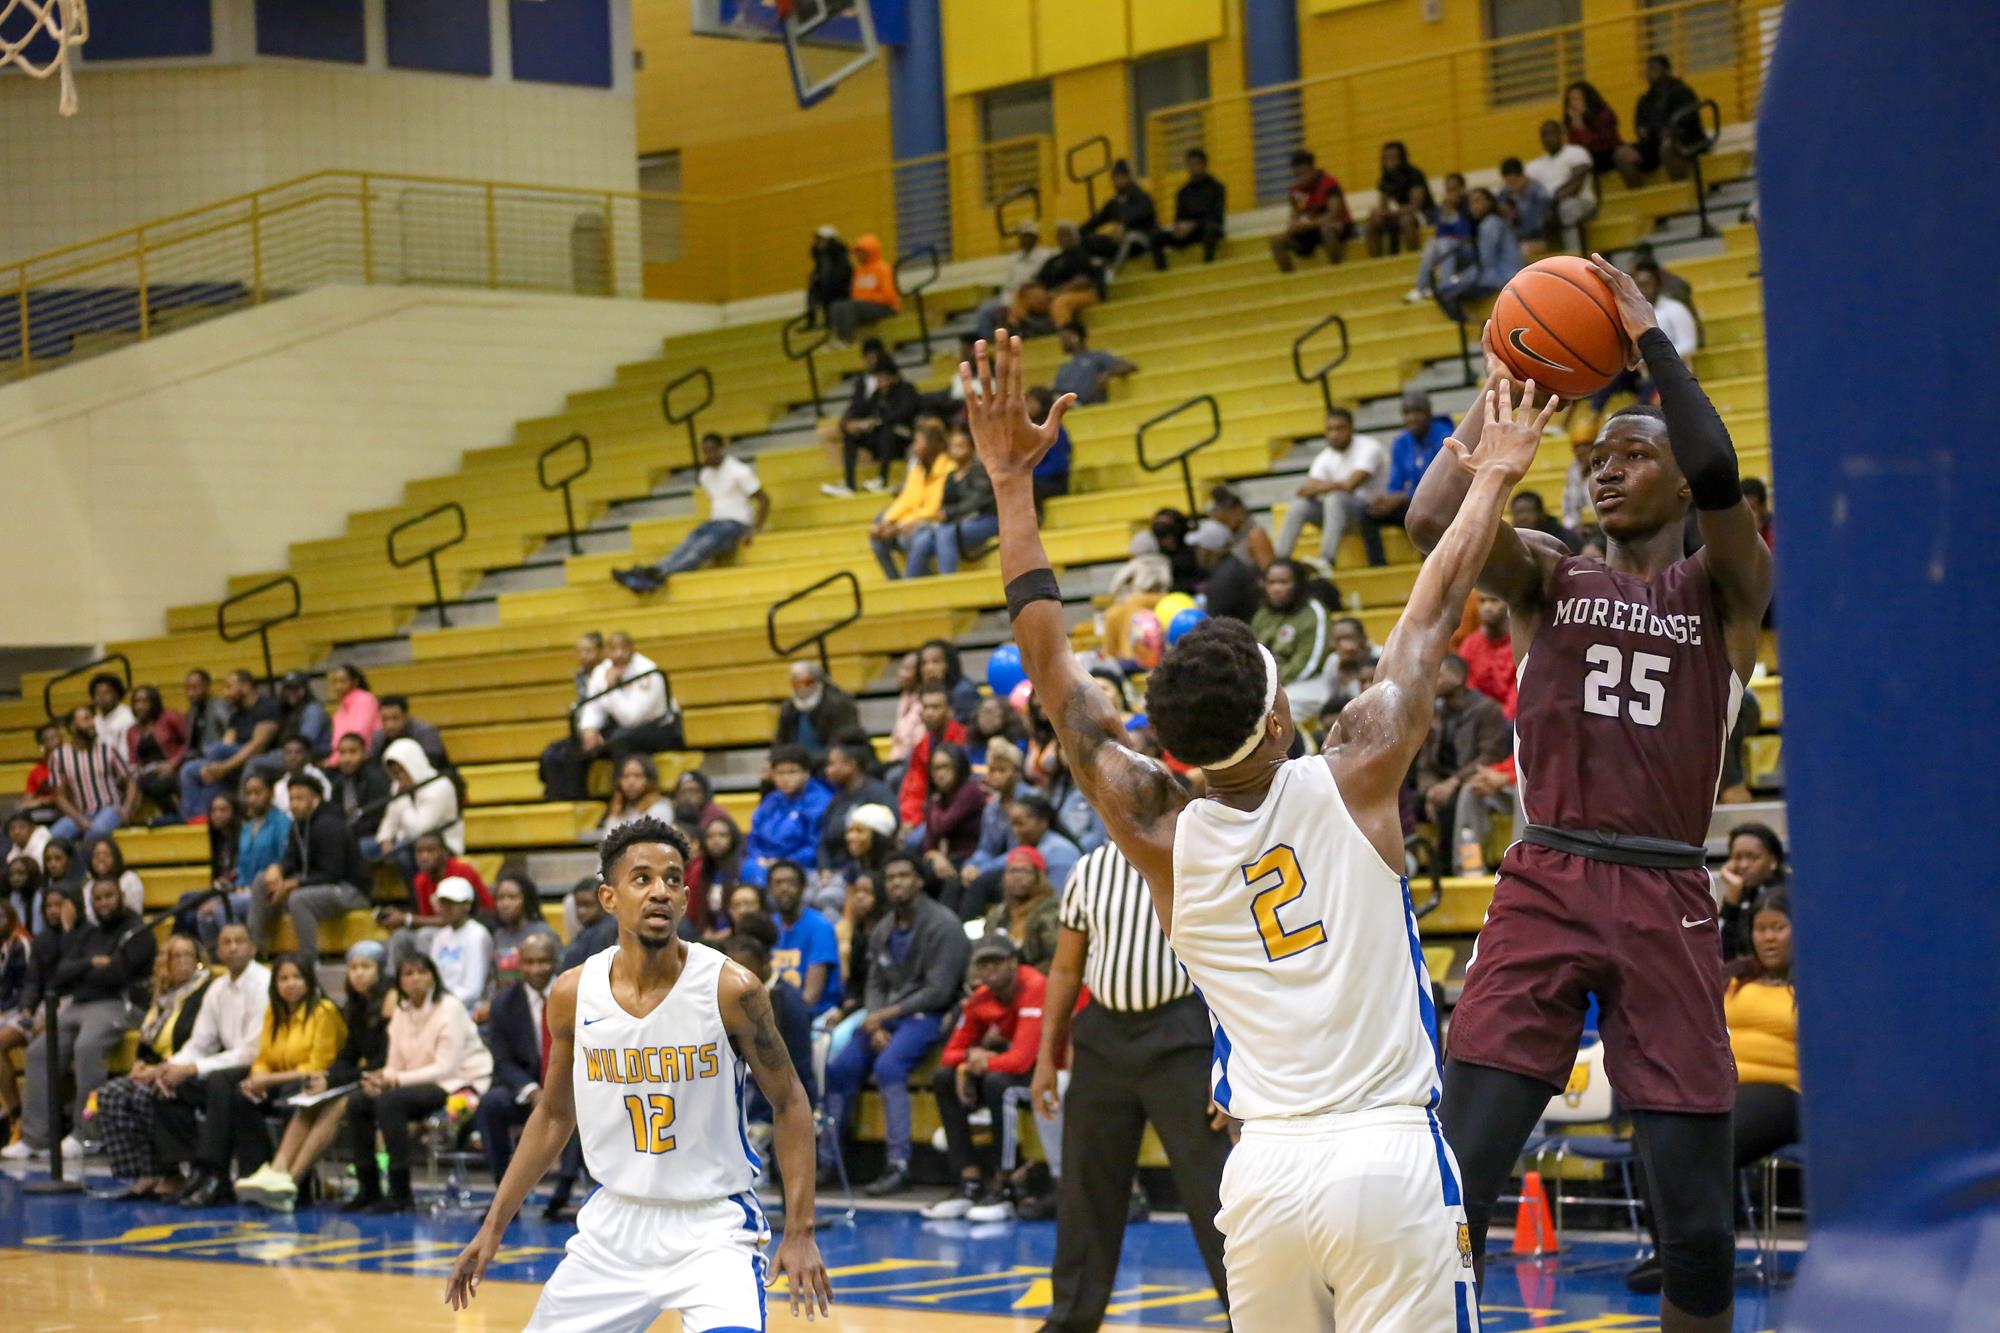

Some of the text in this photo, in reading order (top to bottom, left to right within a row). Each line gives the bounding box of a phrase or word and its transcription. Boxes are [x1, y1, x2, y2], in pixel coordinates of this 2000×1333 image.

[1584, 643, 1671, 727] 25
[1241, 843, 1328, 962] 2
[583, 1042, 719, 1084] WILDCATS
[624, 1094, 677, 1155] 12
